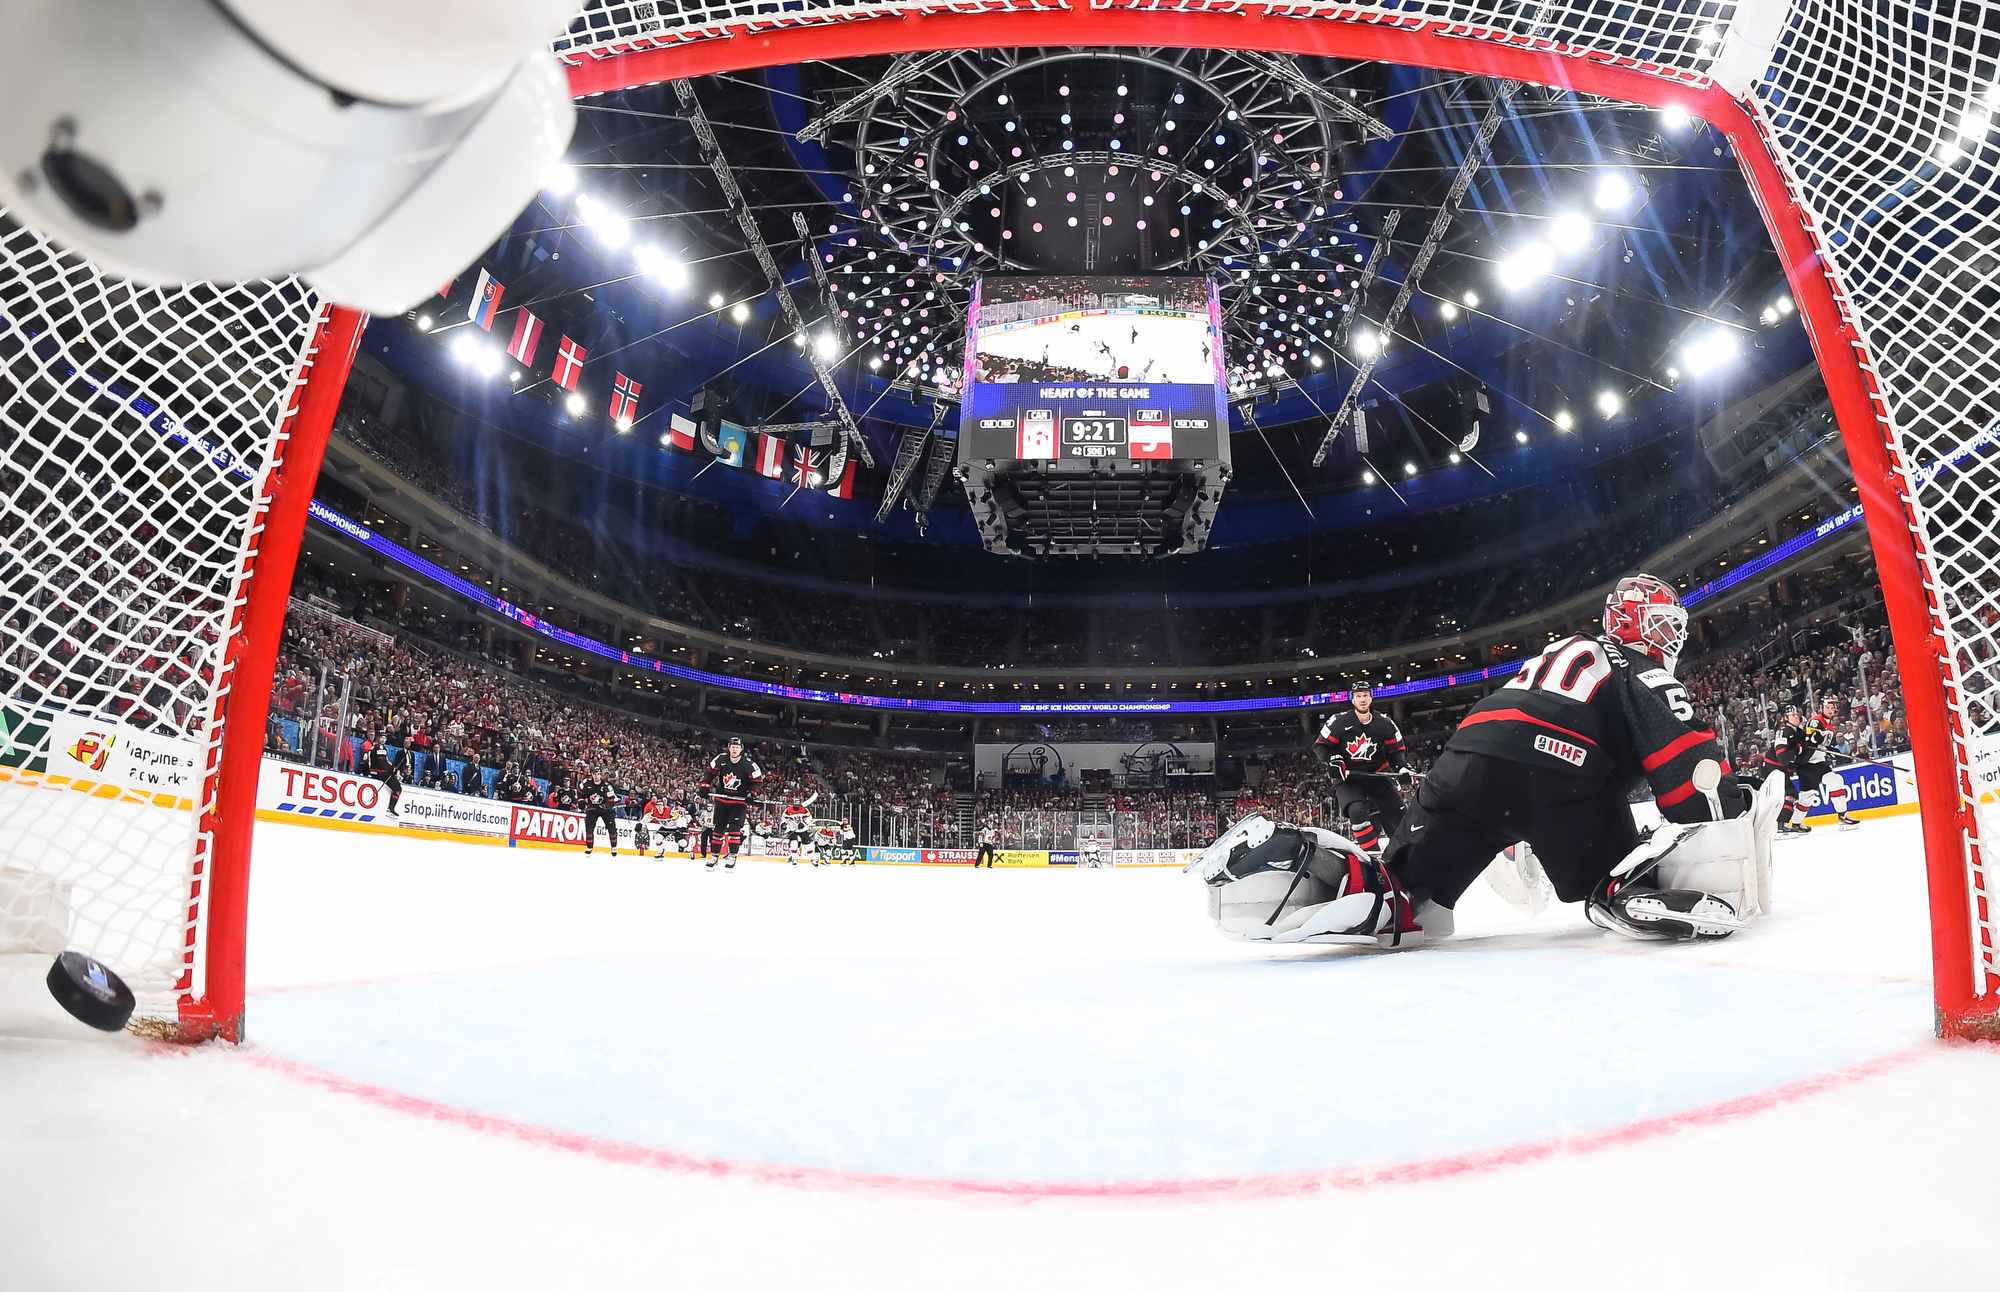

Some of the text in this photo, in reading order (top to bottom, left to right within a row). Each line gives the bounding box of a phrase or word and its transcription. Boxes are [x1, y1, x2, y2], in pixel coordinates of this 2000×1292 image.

[1040, 388, 1075, 399] HEART
[1097, 388, 1117, 399] THE
[1119, 388, 1150, 399] GAME
[1141, 411, 1158, 420] AUT
[1072, 421, 1116, 442] 9:21
[1816, 520, 1835, 537] 2024
[1834, 510, 1852, 527] IIHF
[1119, 703, 1171, 711] CHAMPIONSHIP
[1547, 740, 1583, 762] IIHF
[147, 772, 181, 786] wrk
[280, 767, 379, 810] TESCO
[404, 799, 508, 826] shop.iihfworlds.com
[880, 849, 916, 862] Tipsport
[938, 850, 979, 860] STRAUSS
